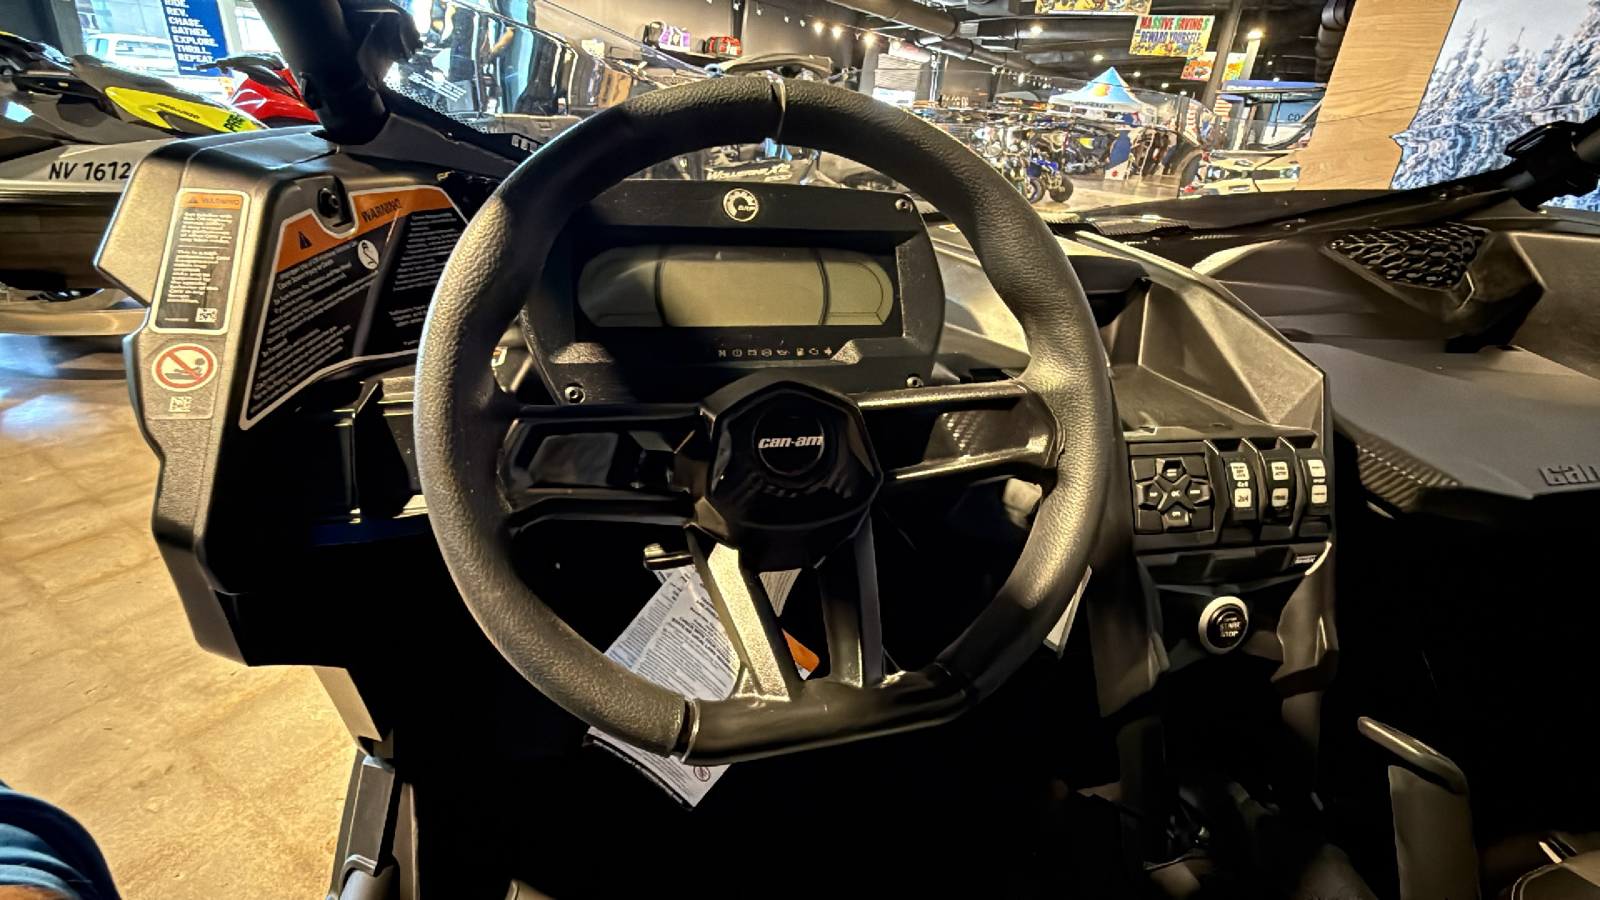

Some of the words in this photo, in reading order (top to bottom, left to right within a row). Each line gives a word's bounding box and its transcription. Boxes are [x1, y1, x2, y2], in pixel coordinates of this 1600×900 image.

[168, 16, 204, 28] CHASE.
[1141, 16, 1174, 30] MASSIVE
[1174, 17, 1210, 31] SAVINGS
[171, 25, 211, 38] GATHER.
[1140, 31, 1168, 43] REWARD
[173, 34, 219, 48] EXPLORE.
[175, 44, 212, 55] THRILL.
[48, 161, 78, 180] NV
[83, 161, 131, 181] 1612
[201, 196, 240, 206] WARNING
[361, 198, 402, 223] WARNING
[737, 204, 756, 212] BRP
[758, 436, 824, 449] can-am
